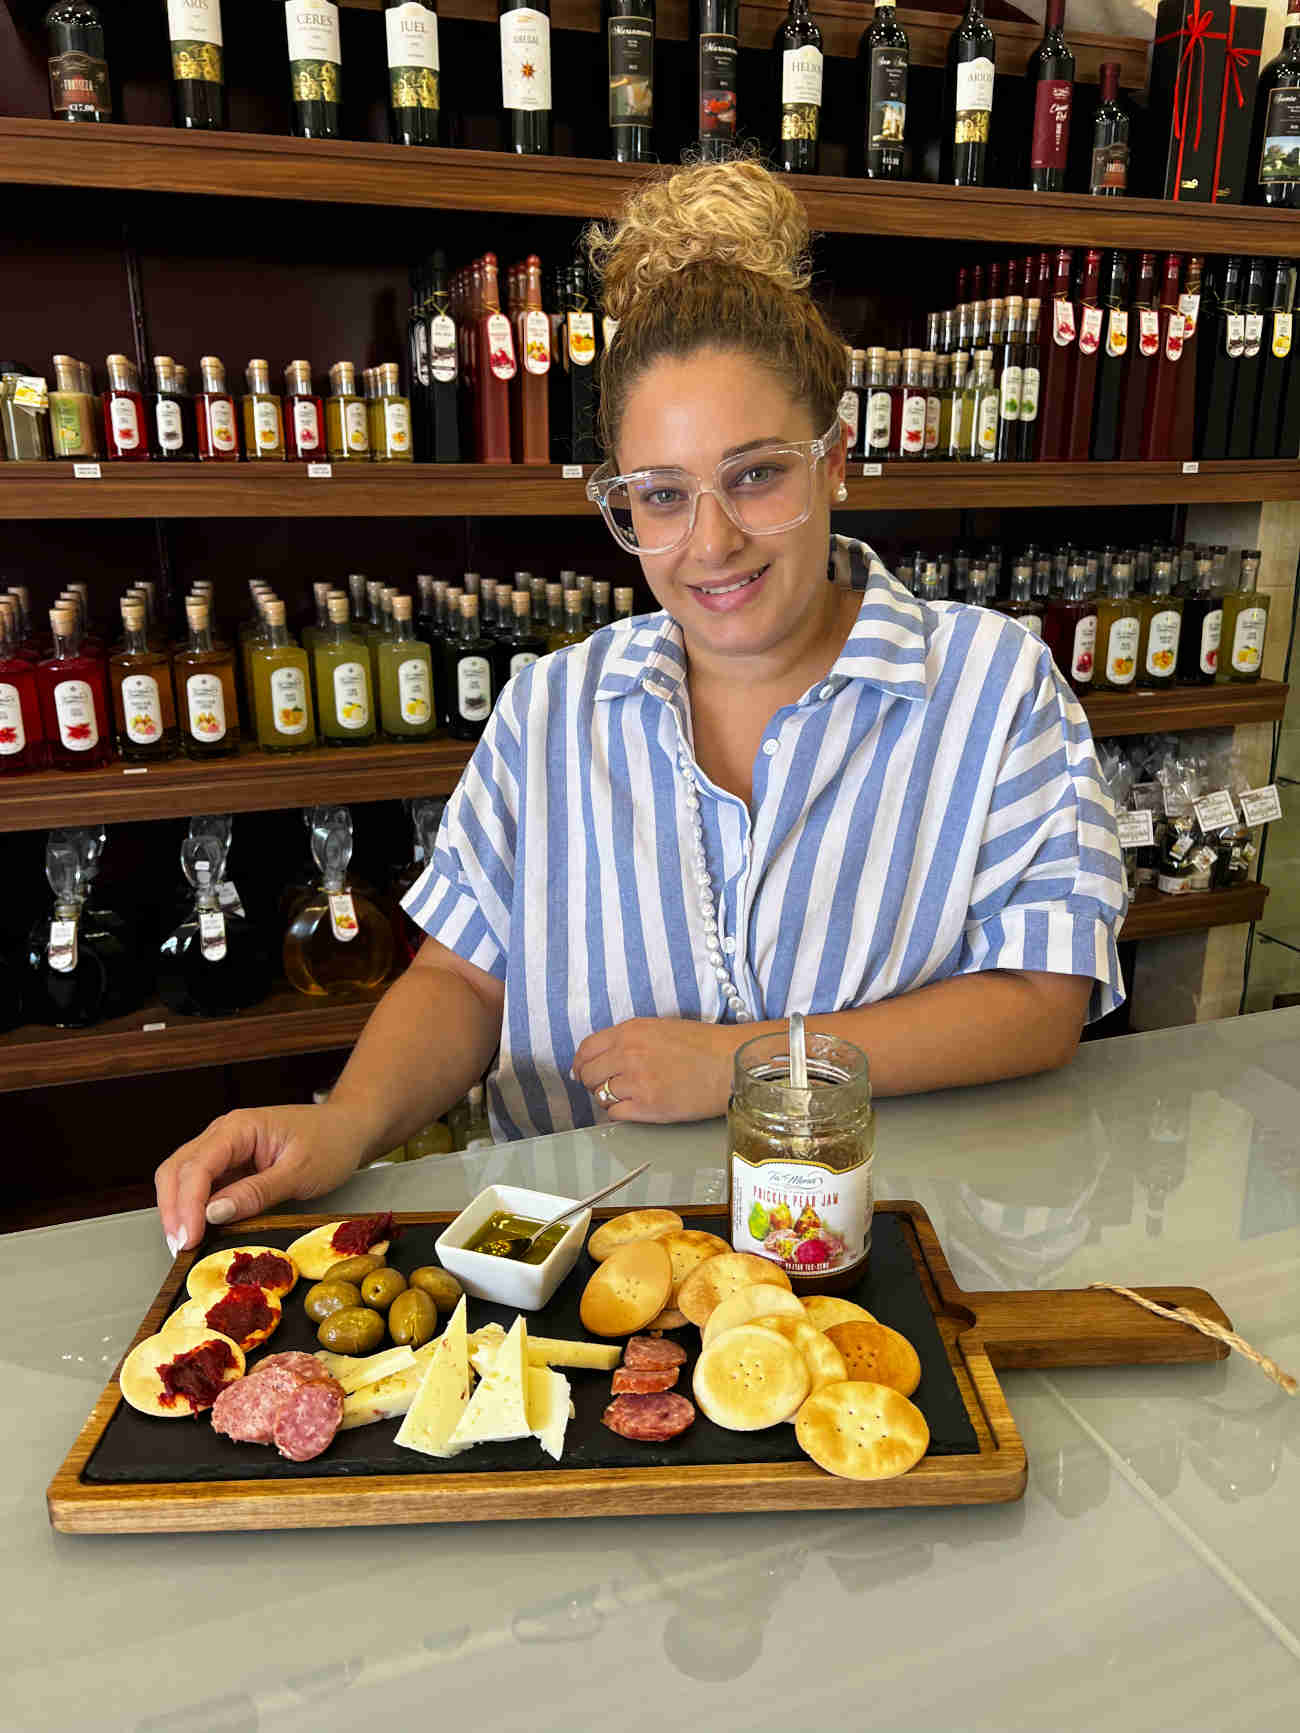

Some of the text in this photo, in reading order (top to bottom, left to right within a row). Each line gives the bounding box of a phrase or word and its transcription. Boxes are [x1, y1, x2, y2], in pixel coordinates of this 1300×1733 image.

[296, 13, 333, 26] CERES
[792, 61, 822, 73] HELIO
[793, 1195, 816, 1208] PEAR
[821, 1191, 839, 1208] JAM
